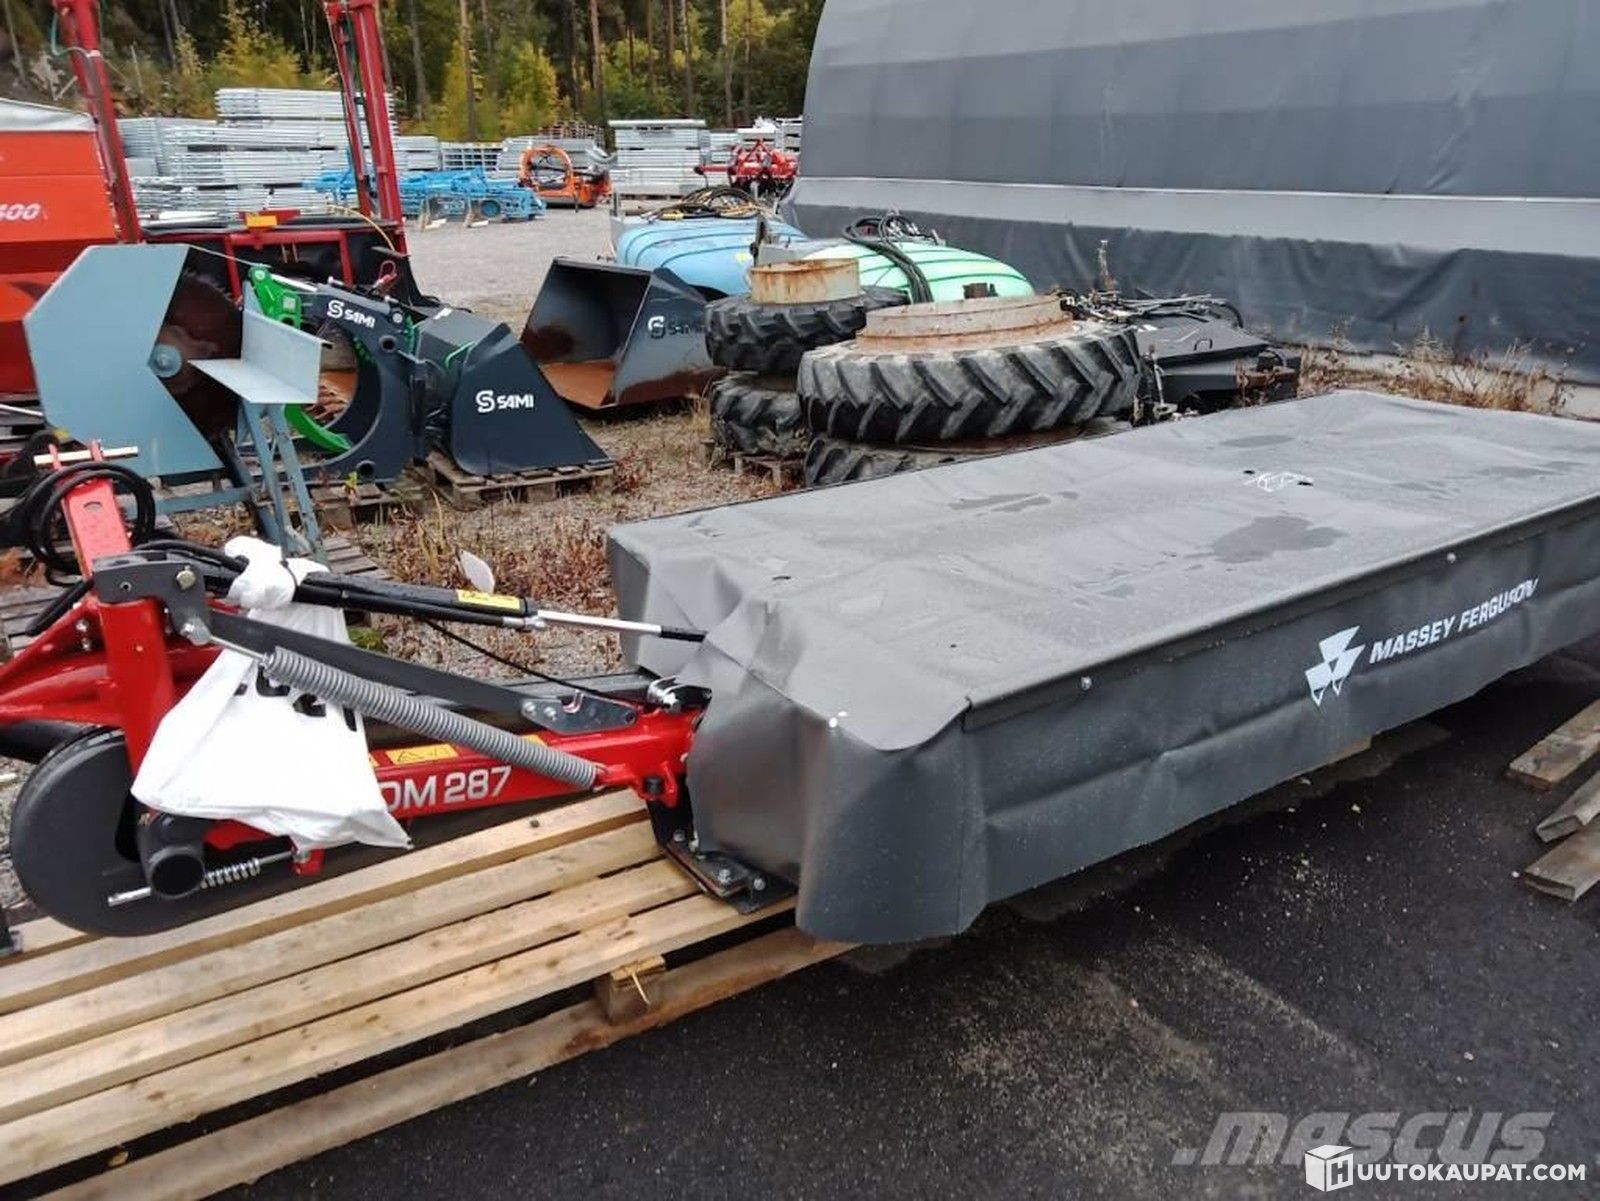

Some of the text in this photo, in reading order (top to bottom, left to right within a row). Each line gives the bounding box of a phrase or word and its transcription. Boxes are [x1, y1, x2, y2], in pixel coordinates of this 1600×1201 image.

[344, 309, 376, 328] SAMI
[496, 394, 535, 409] SAMI
[1369, 578, 1539, 664] MASSEY FERGUSON
[443, 765, 512, 804] 287
